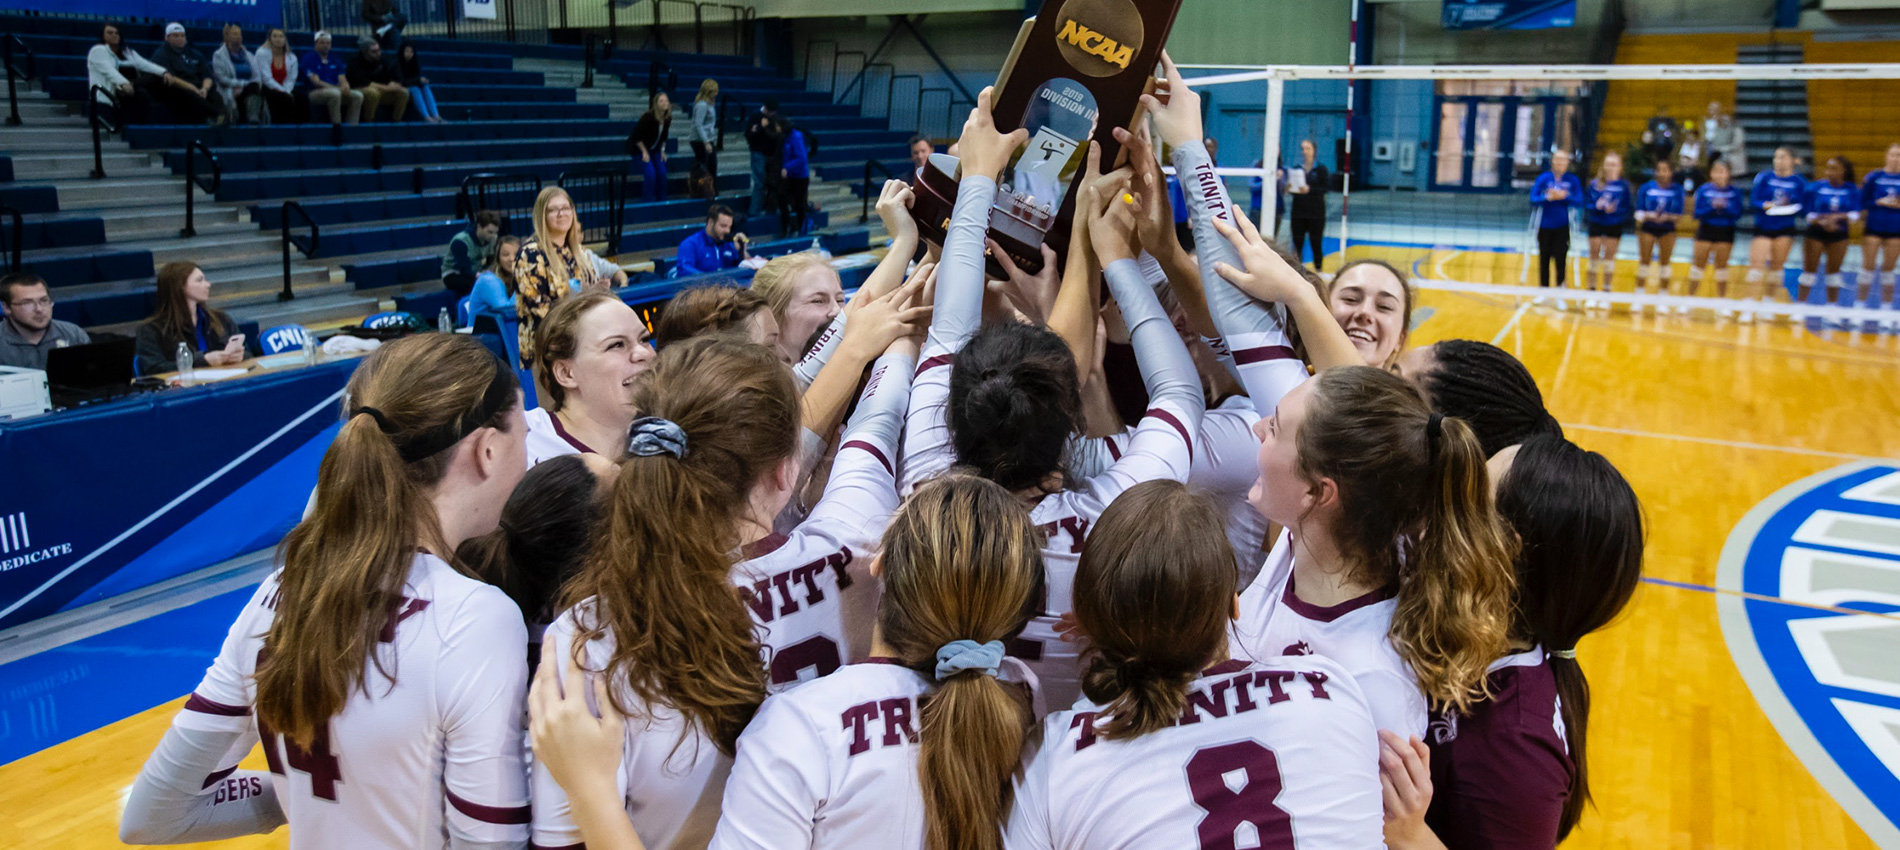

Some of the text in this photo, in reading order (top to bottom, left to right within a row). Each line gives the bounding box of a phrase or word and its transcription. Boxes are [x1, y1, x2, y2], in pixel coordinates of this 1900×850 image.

[1056, 19, 1136, 70] NCAA
[1040, 87, 1086, 116] DIVISION
[1062, 86, 1085, 102] 2019
[1194, 162, 1228, 220] TRINITY
[0, 542, 73, 572] EDICATE
[212, 776, 263, 806] GERS
[1183, 736, 1299, 850] 8
